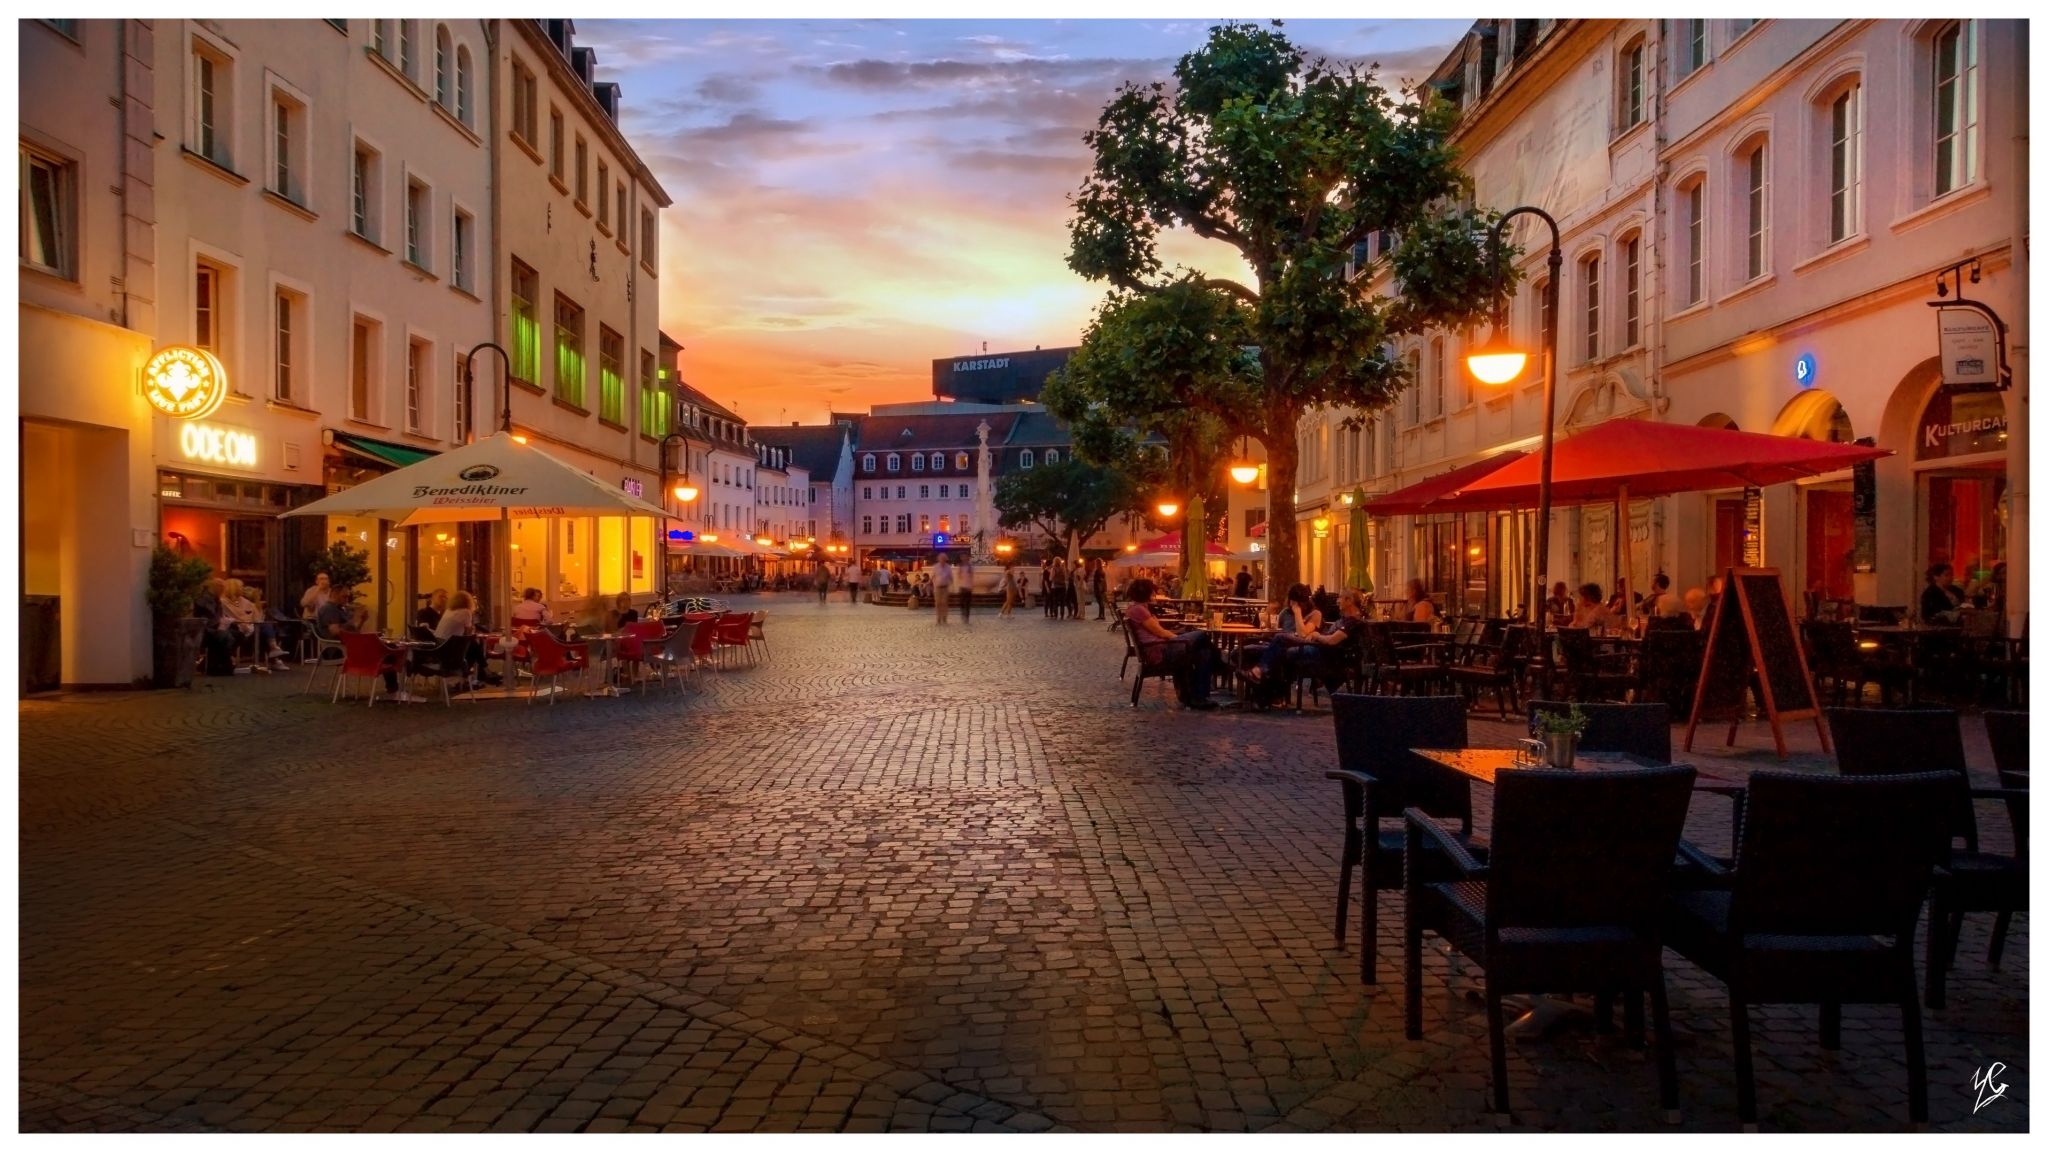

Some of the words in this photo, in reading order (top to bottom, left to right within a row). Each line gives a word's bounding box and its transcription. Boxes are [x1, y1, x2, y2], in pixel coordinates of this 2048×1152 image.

[148, 350, 209, 377] AFFLICTION
[953, 358, 1010, 372] KARSTADT
[181, 423, 257, 465] ODEON
[412, 485, 529, 499] Benediktiner
